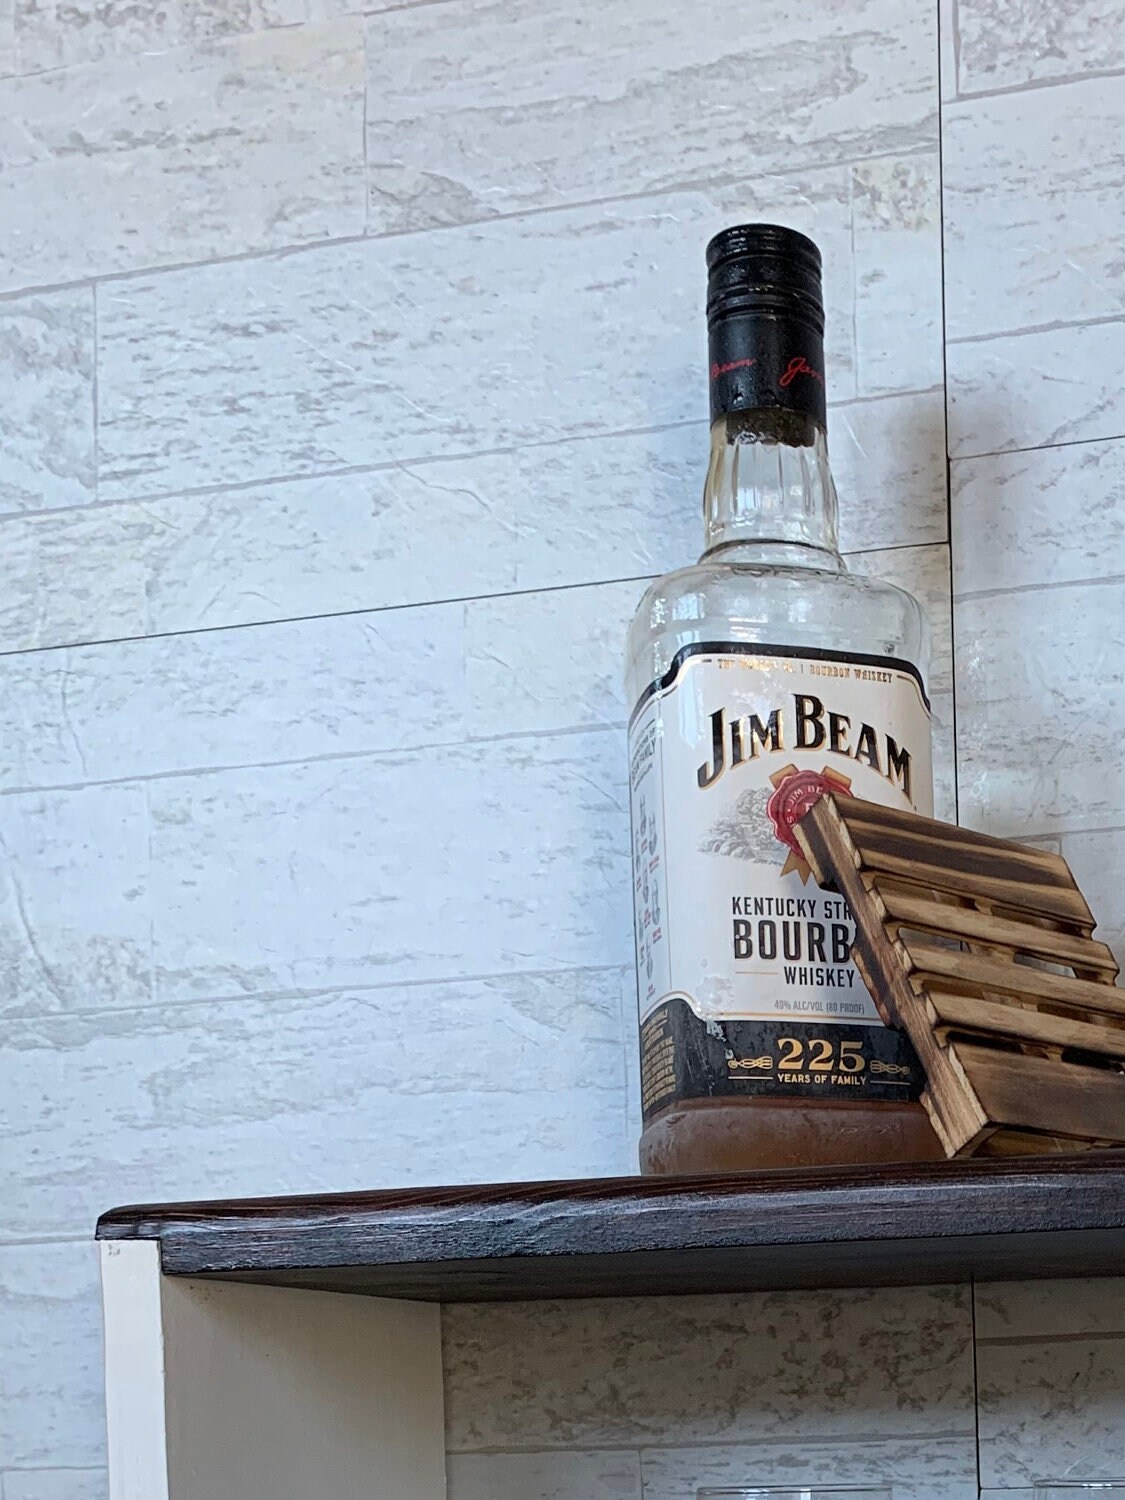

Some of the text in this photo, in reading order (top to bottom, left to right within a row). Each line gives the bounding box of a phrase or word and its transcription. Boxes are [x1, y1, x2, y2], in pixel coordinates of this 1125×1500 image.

[809, 664, 850, 679] BOURBON
[854, 668, 892, 683] WHISKEY
[697, 707, 785, 790] JIM
[791, 693, 913, 805] BEAM
[788, 788, 804, 805] JIM
[732, 896, 817, 918] KENTUCKY
[733, 918, 851, 963] BOURB
[783, 965, 855, 988] WHISKEY
[774, 999, 866, 1015] 40% ALC/VOL (80 PROOF)
[777, 1038, 865, 1072] 225
[777, 1073, 867, 1086] YEARS OF FAMILY
